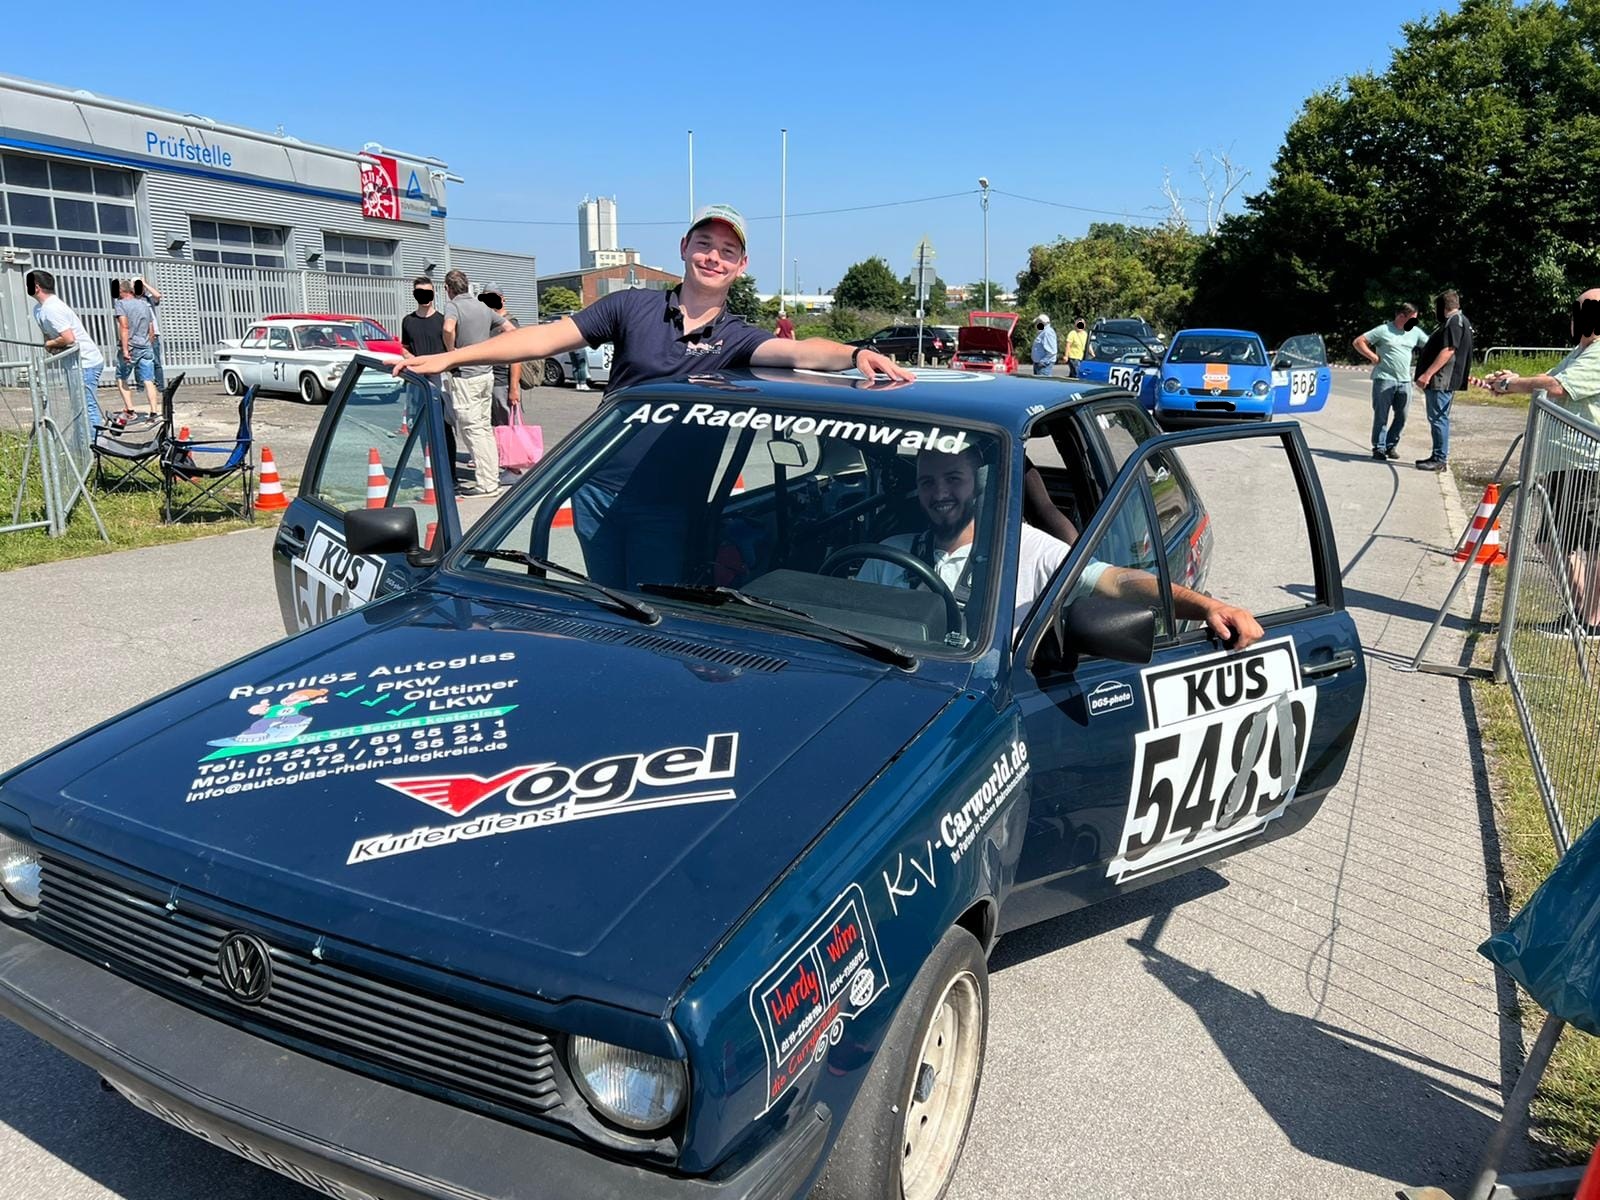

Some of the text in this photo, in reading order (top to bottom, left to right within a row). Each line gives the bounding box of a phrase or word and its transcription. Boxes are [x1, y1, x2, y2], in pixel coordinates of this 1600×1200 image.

[146, 131, 232, 167] Prüfstelle
[273, 361, 286, 382] 51
[1110, 368, 1142, 393] 568
[1292, 372, 1318, 397] 568
[622, 402, 969, 456] AC Radevormwald
[368, 651, 516, 678] Autoglas
[376, 675, 442, 693] PKW
[403, 679, 519, 701] Oldtimer
[1183, 656, 1269, 717] KÜS
[429, 693, 494, 711] LKW
[1091, 692, 1131, 710] DGS-photo
[191, 766, 273, 790] Mobil:
[282, 753, 346, 773] 0172
[374, 743, 403, 757] 91
[414, 738, 445, 751] 35
[454, 732, 484, 746] 24
[493, 729, 508, 740] 3
[198, 758, 246, 776] Tel:
[257, 742, 338, 764] 02243
[369, 733, 401, 746] 89
[411, 727, 442, 740] 55
[452, 722, 480, 735] 21
[494, 719, 505, 729] 1
[376, 732, 740, 818] Vogel
[349, 803, 571, 862] Kurierdienst
[771, 965, 820, 1025] Hardy
[771, 1074, 788, 1097] die
